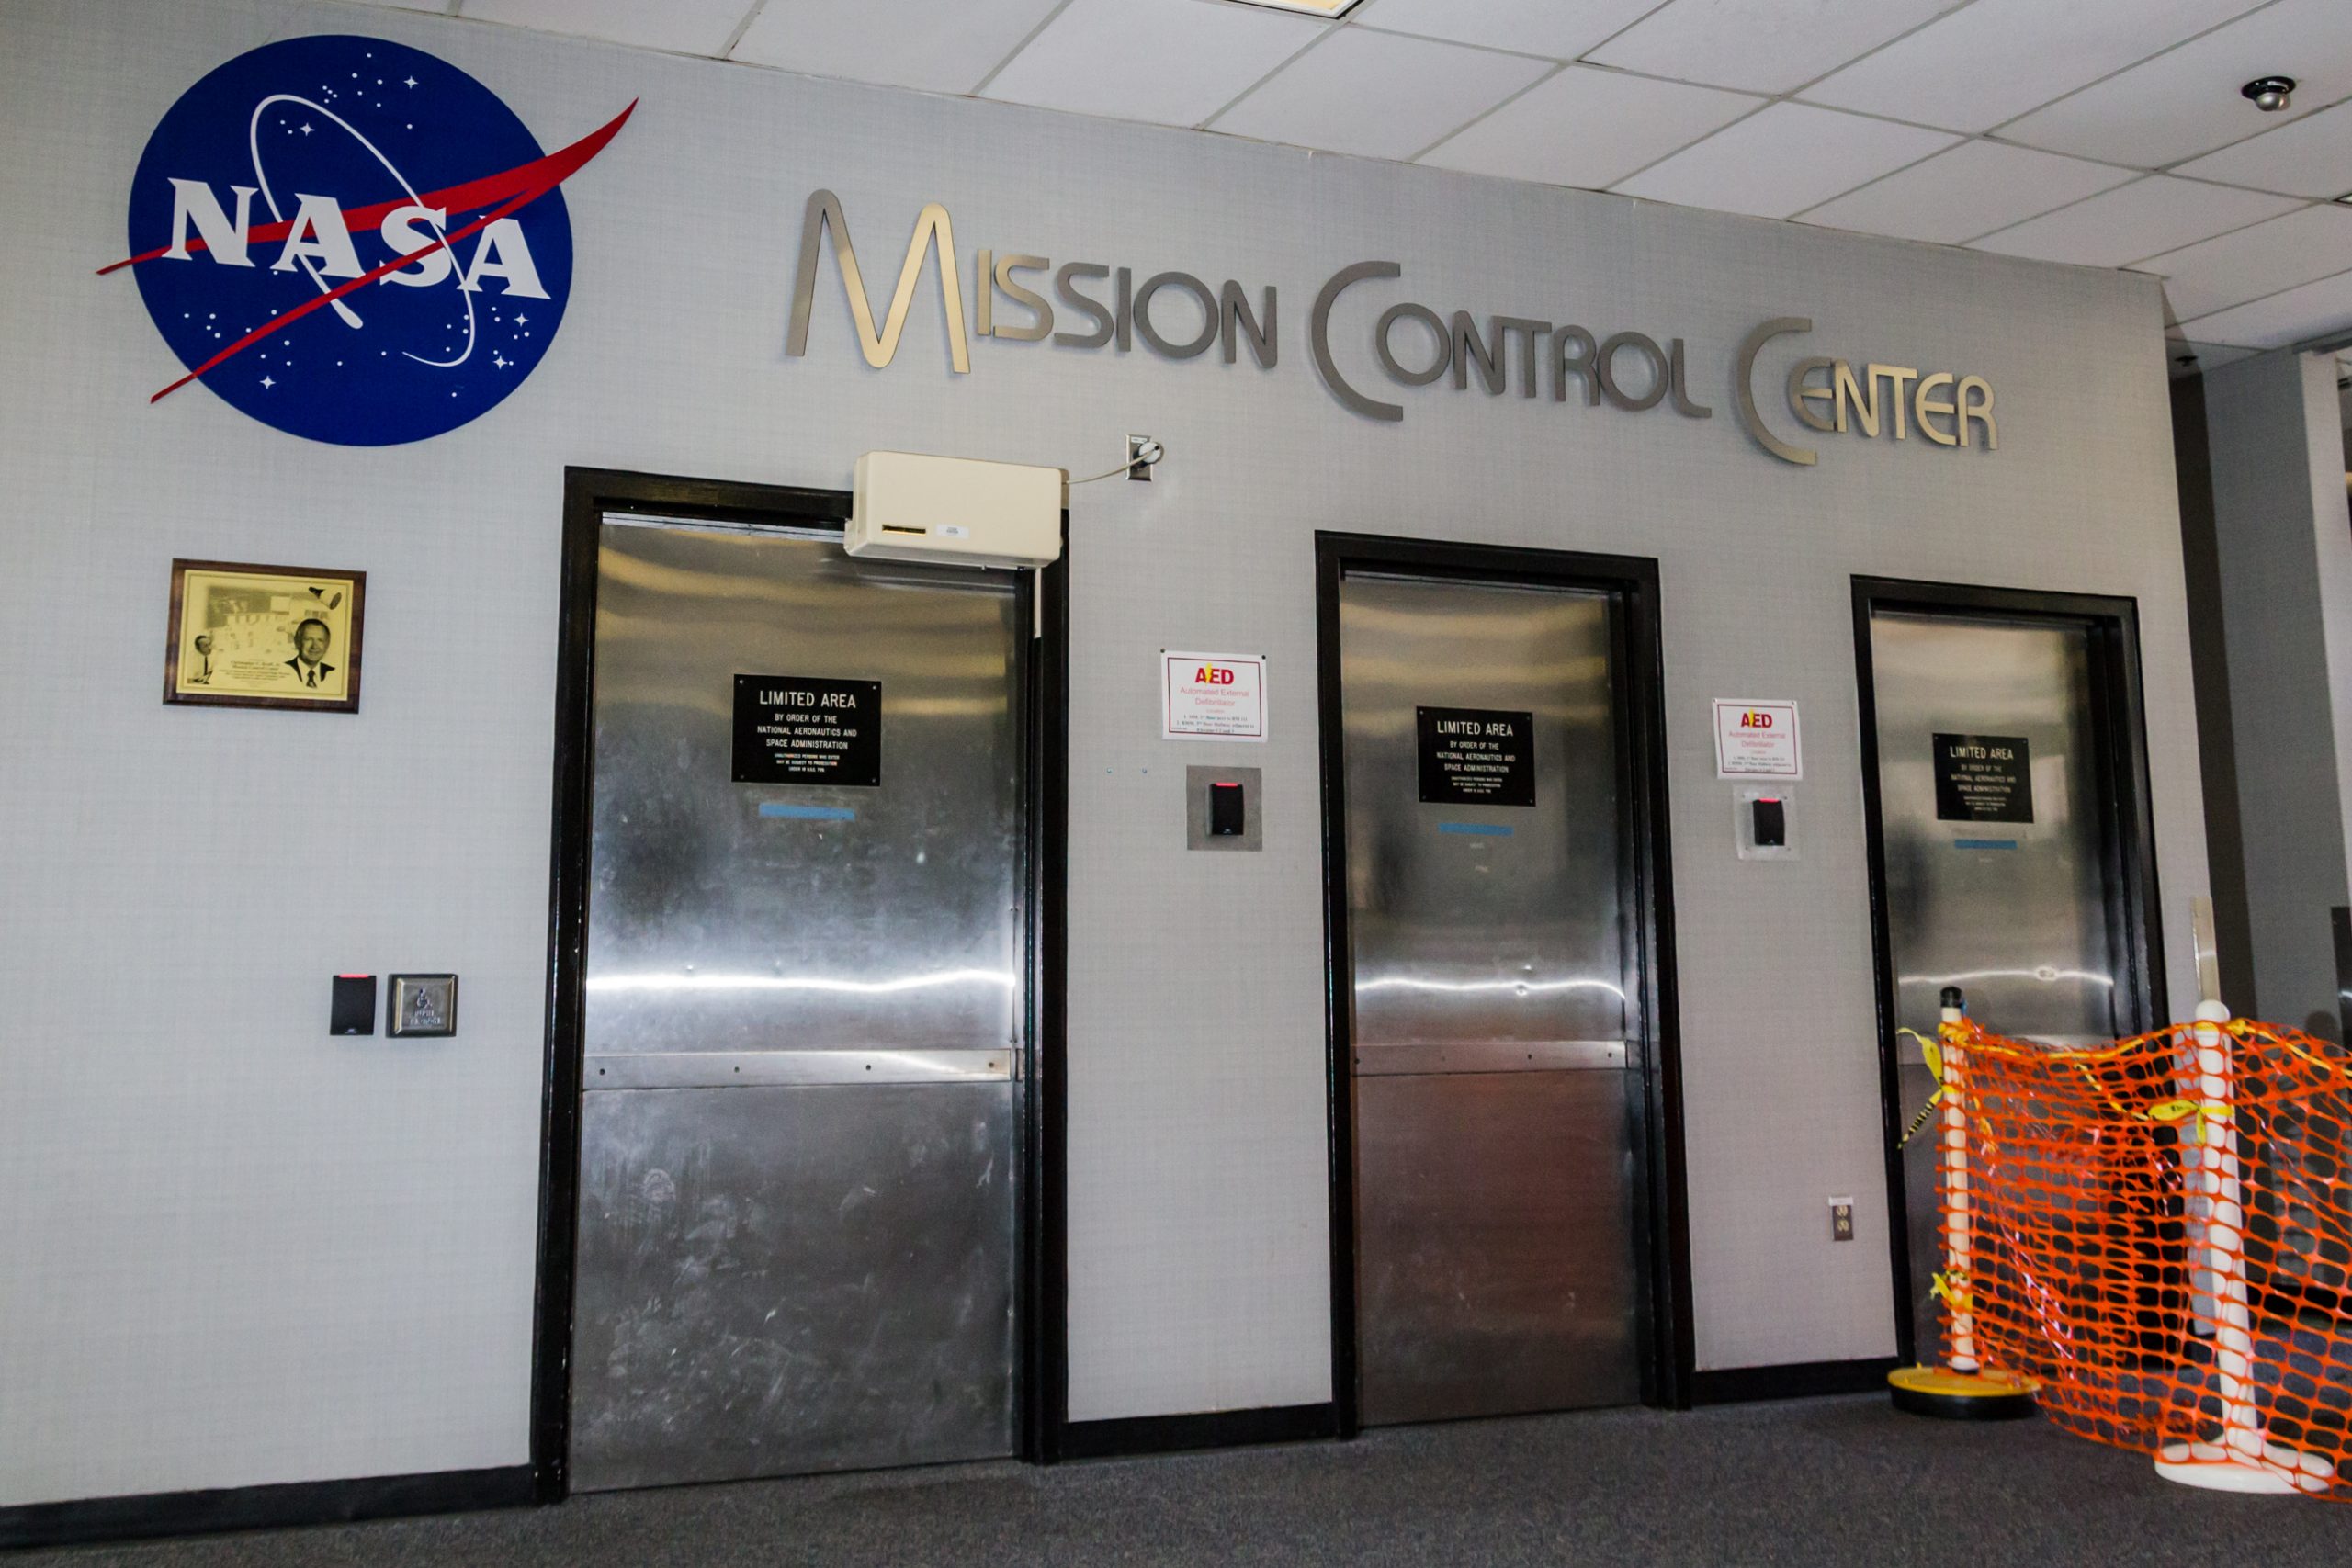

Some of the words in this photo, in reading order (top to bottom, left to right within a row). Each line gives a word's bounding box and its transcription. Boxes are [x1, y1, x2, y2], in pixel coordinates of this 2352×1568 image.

[161, 177, 551, 299] NASA
[786, 188, 1278, 375] MISSION
[1310, 261, 1713, 422] CONTROL
[1737, 317, 1999, 466] CENTER
[1194, 667, 1235, 685] AED
[760, 690, 815, 706] LIMITED
[820, 693, 856, 708] AREA
[1180, 686, 1219, 696] Automated
[1220, 688, 1250, 698] External
[786, 714, 809, 722] ORDER
[812, 715, 820, 723] OF
[824, 715, 837, 724] THE
[1740, 712, 1773, 728] AED
[757, 726, 791, 735] NATIONAL
[794, 728, 841, 737] AERONAUTICS
[843, 728, 857, 737] AND
[1437, 720, 1481, 735] LIMITED
[1486, 723, 1514, 737] AREA
[766, 739, 787, 748] SPACE
[790, 739, 848, 750] ADMINISTRATION
[1450, 740, 1457, 749] BY
[1459, 741, 1478, 750] ORDER
[1488, 742, 1499, 750] THE
[1436, 751, 1464, 761] NATIONAL
[1465, 752, 1503, 762] AERONAUTICS
[1504, 754, 1516, 763] AND
[1950, 745, 1986, 760] LIMITED
[1990, 748, 2014, 761] AREA
[1444, 763, 1462, 772] SPACE
[1464, 763, 1510, 773] ADMINISTRATION
